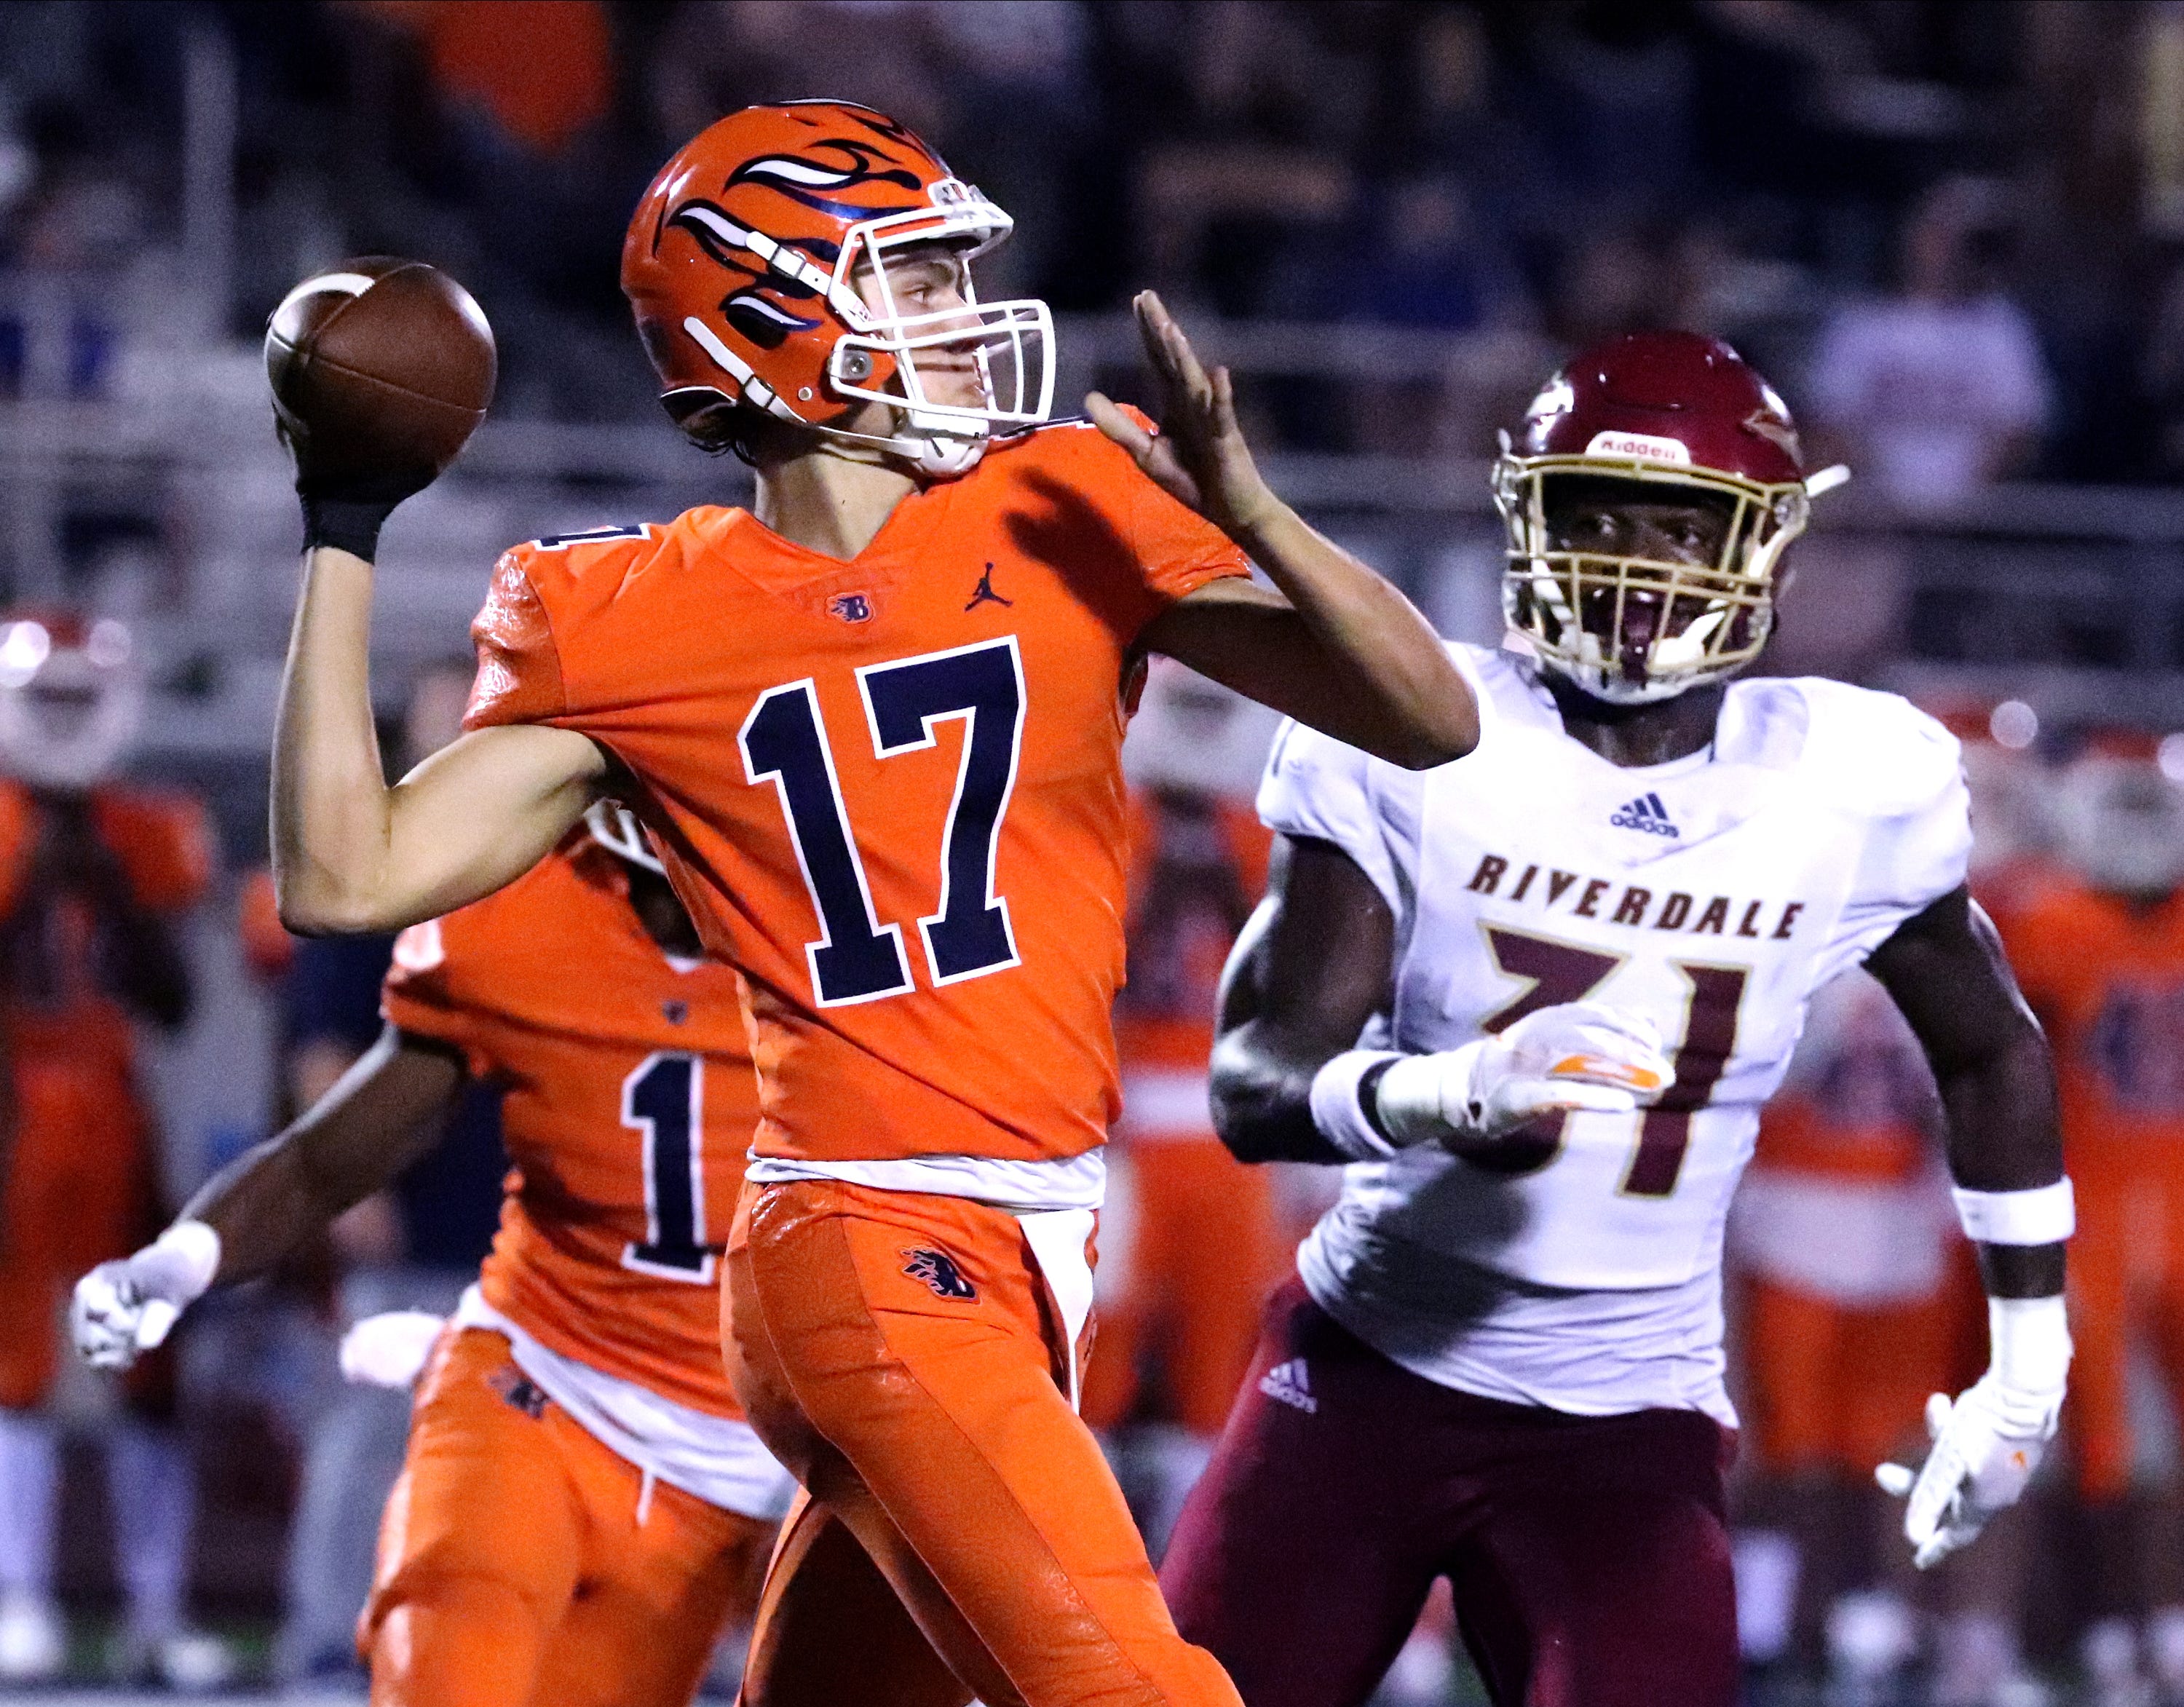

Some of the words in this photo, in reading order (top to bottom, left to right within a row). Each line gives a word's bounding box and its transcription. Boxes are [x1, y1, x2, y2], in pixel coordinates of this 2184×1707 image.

[736, 634, 1027, 1008] 17
[1463, 853, 1806, 940] RIVERDALE
[1610, 814, 1679, 839] adidas
[620, 1050, 716, 1285] 1
